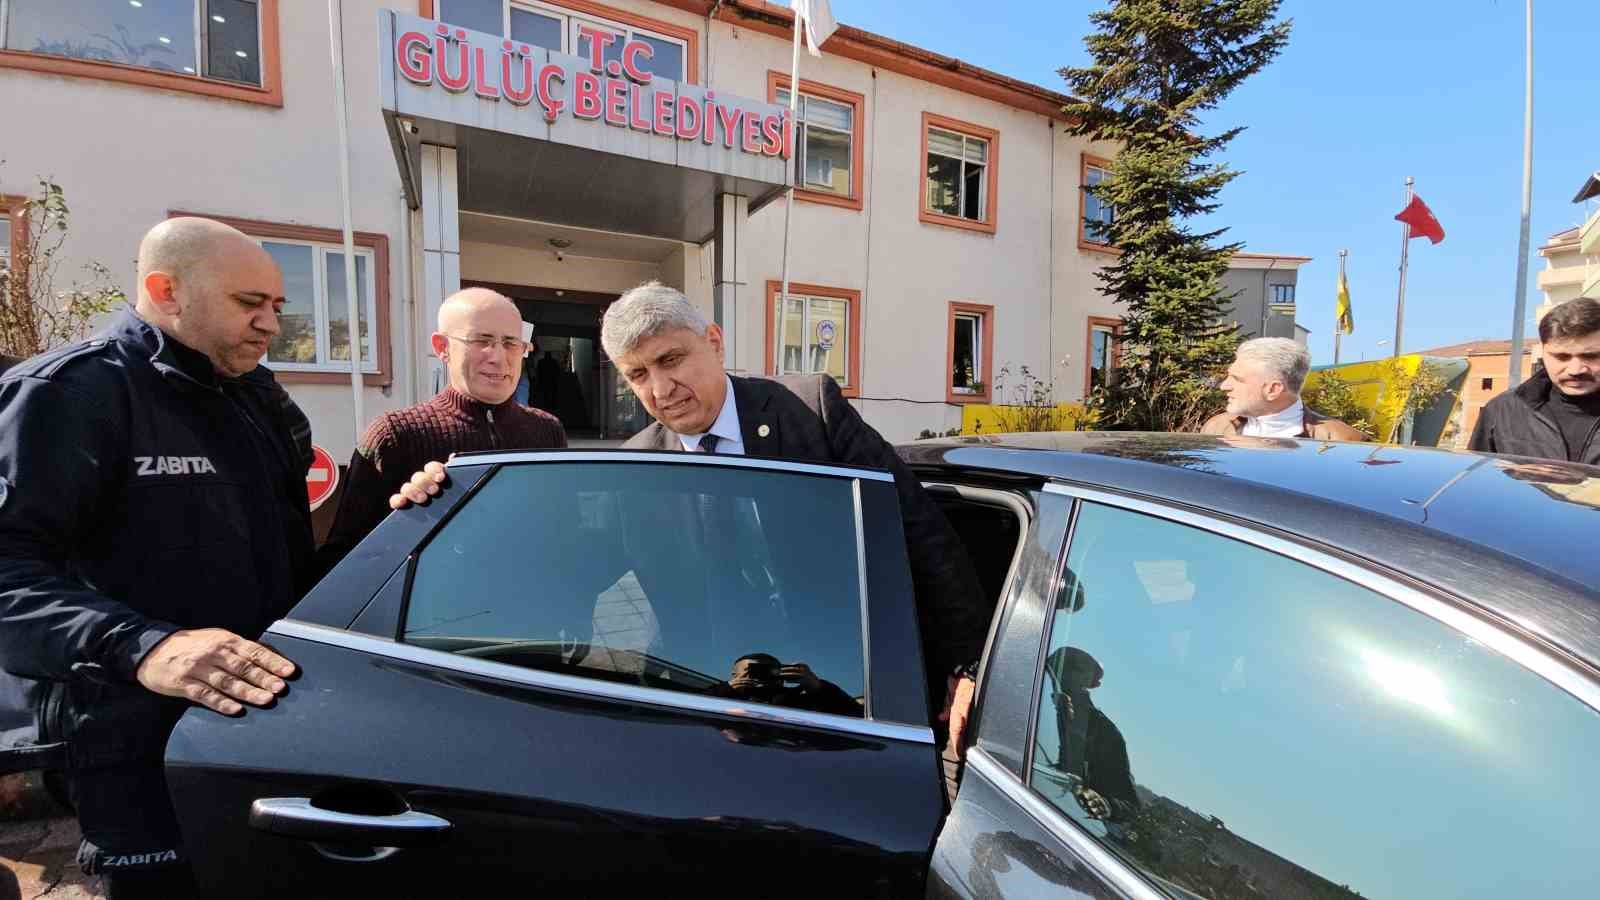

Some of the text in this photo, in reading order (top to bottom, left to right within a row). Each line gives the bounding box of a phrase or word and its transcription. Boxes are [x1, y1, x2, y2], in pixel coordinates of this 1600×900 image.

[578, 24, 655, 83] T.C
[397, 25, 792, 159] GÜLÜÇ BELEDİYESİ
[134, 455, 217, 476] ZABITA
[102, 849, 178, 867] ZABITA
